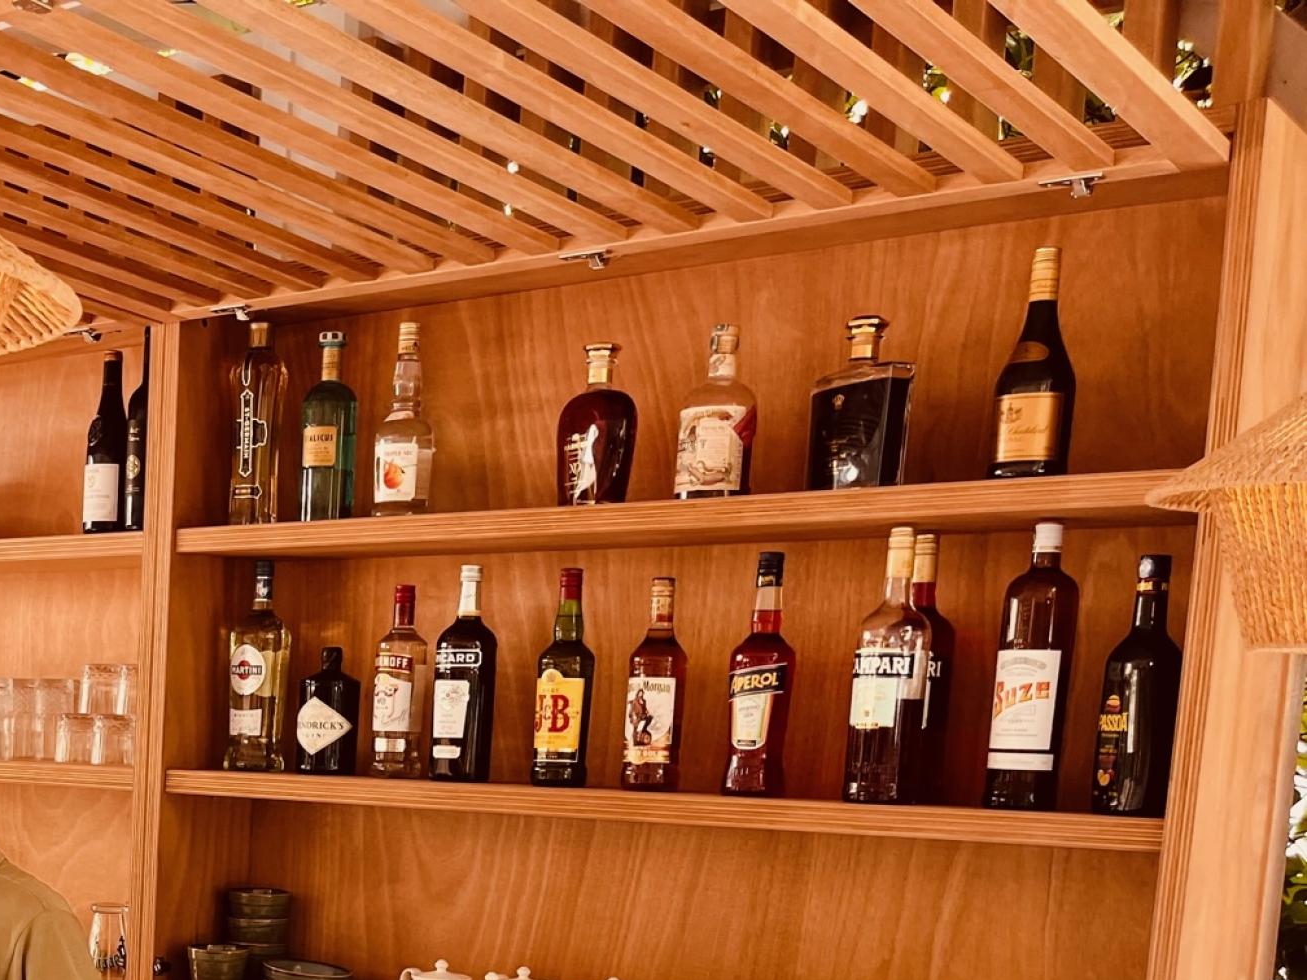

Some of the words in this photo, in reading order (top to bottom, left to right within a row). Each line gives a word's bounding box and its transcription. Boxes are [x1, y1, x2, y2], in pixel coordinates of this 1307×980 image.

[232, 665, 262, 675] MARTINI
[853, 656, 911, 675] AMPARI
[731, 672, 779, 694] APEROL
[299, 720, 345, 731] NDRICK'S
